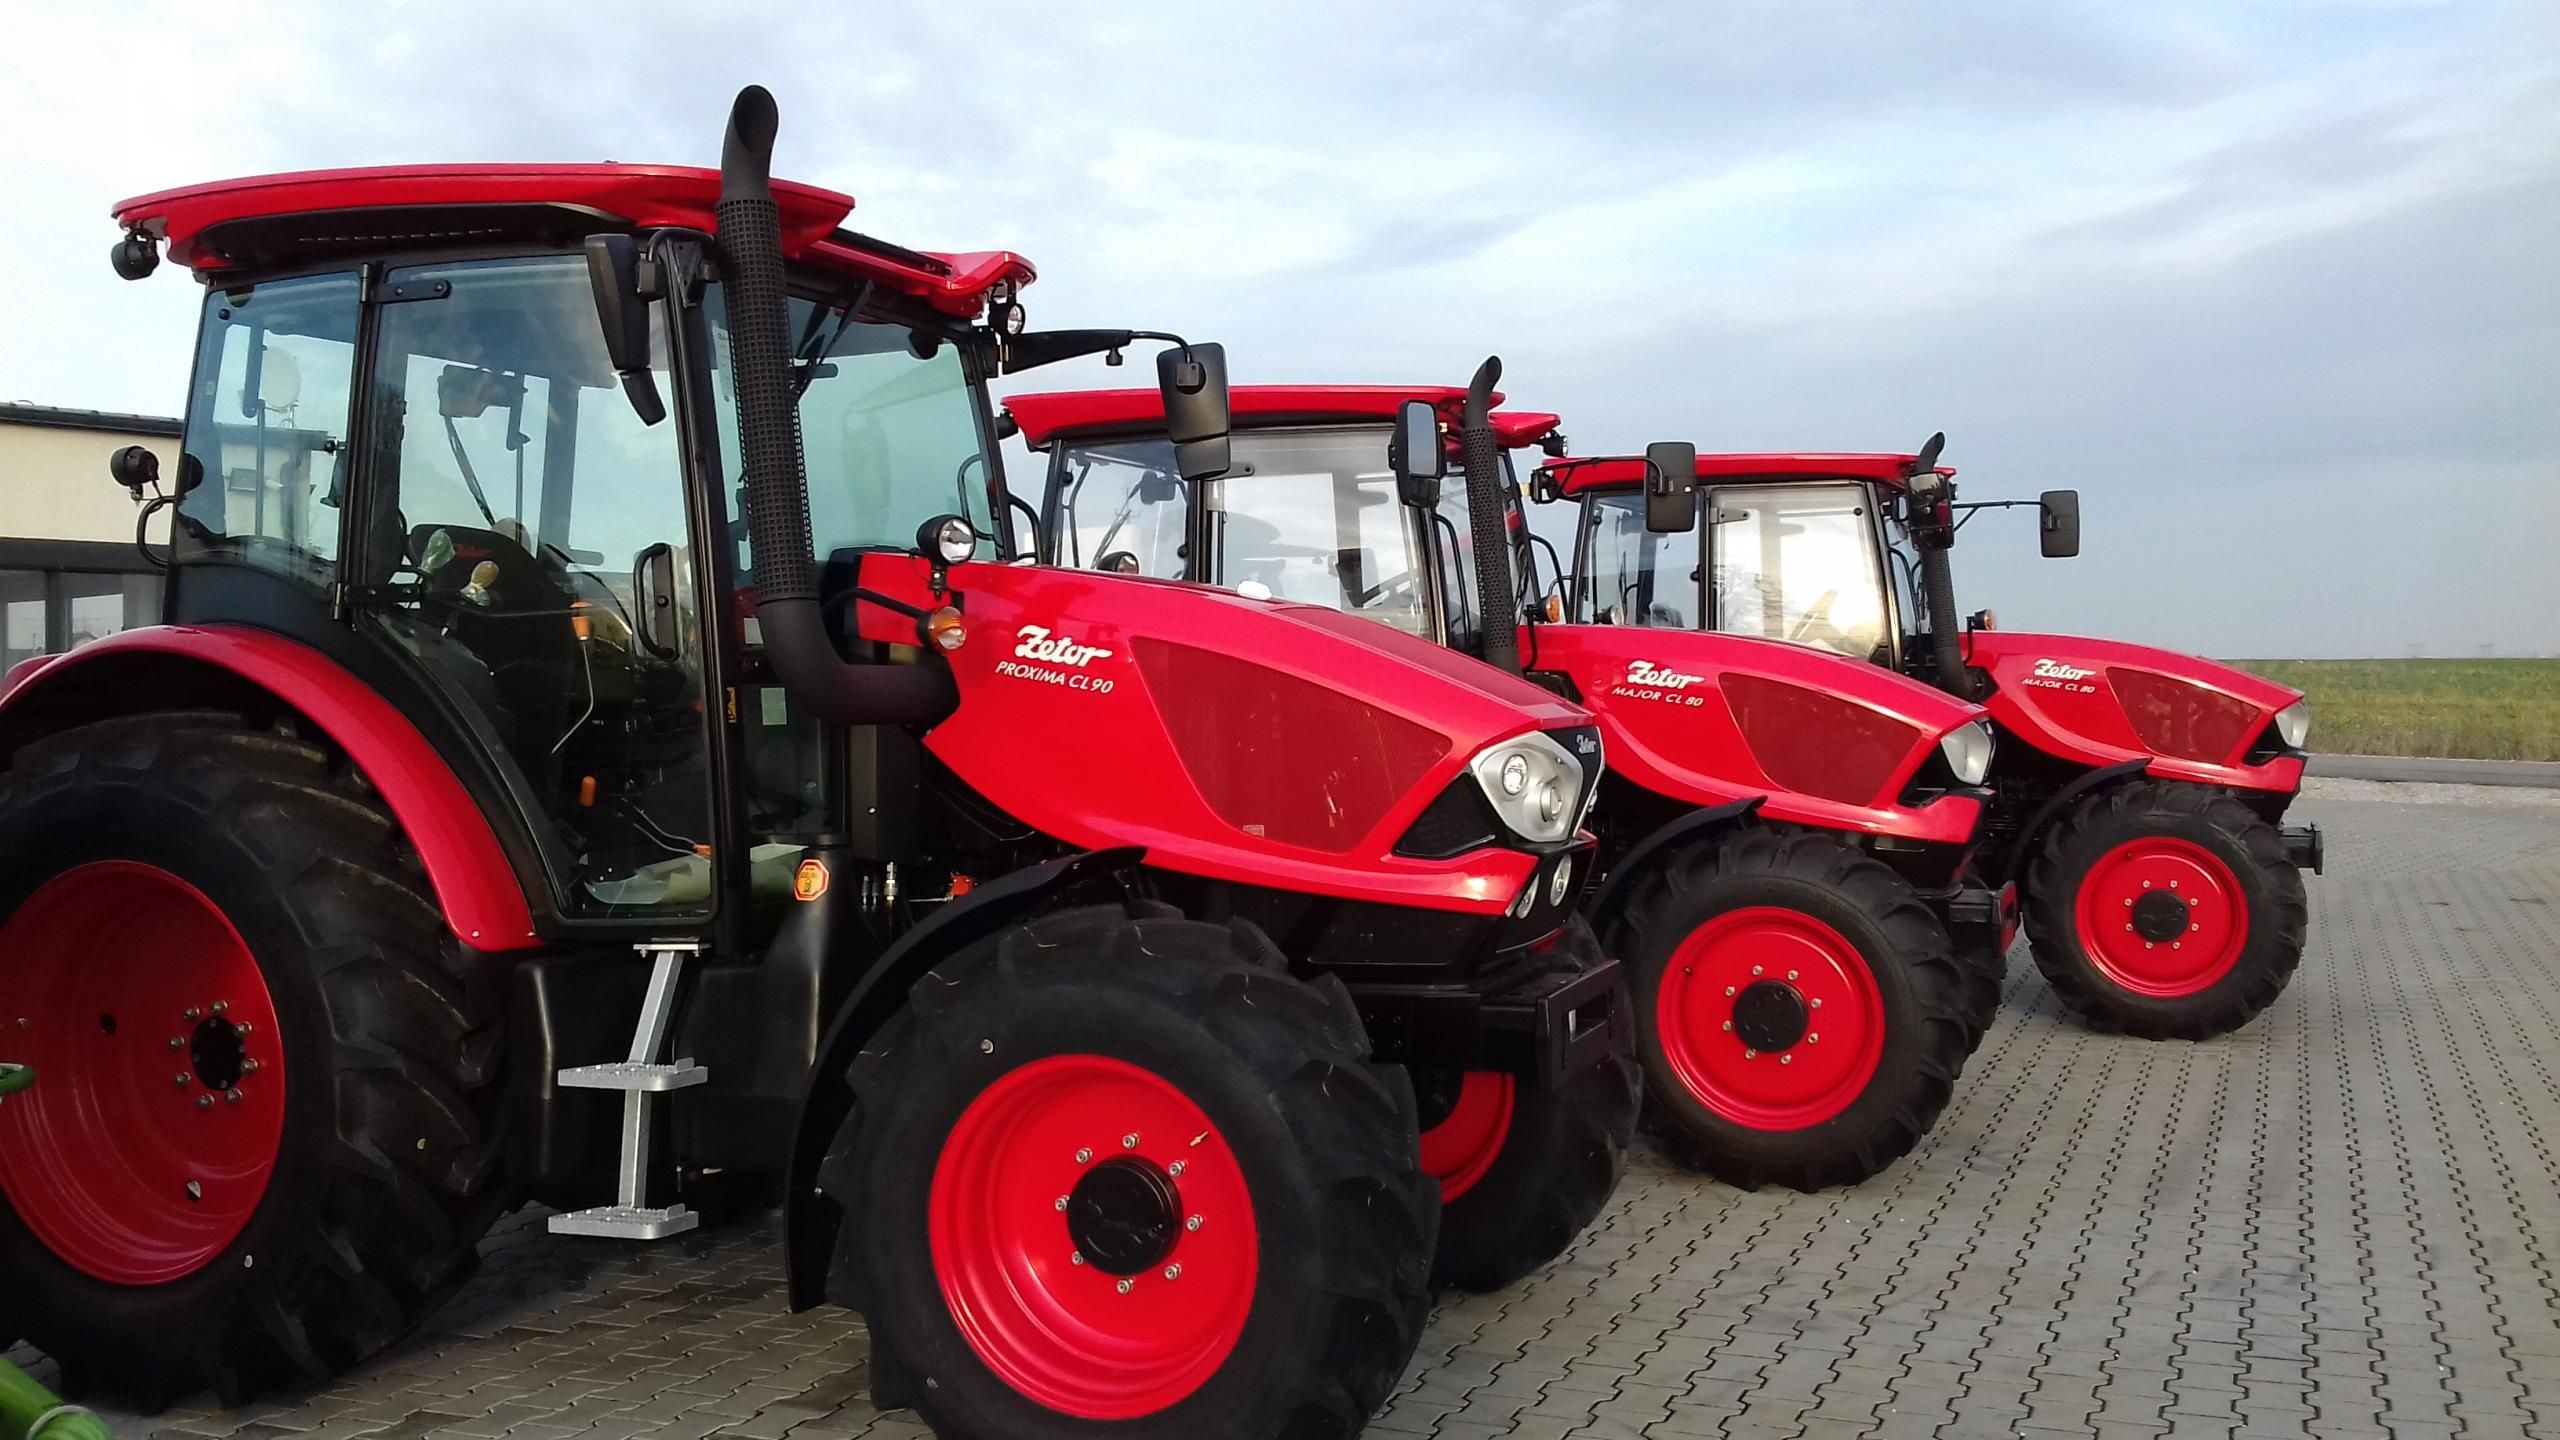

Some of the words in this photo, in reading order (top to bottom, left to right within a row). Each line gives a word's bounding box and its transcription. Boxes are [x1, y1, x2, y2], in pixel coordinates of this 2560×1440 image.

[1014, 624, 1113, 667] Zetor
[994, 660, 1065, 686] PROXIMA
[1626, 659, 1705, 689] Zetor
[2033, 658, 2097, 681] Zetor
[1611, 686, 1662, 701] MAJOR
[1665, 693, 1682, 704] CL
[2021, 678, 2063, 689] MAJOR
[2064, 682, 2079, 692] CL
